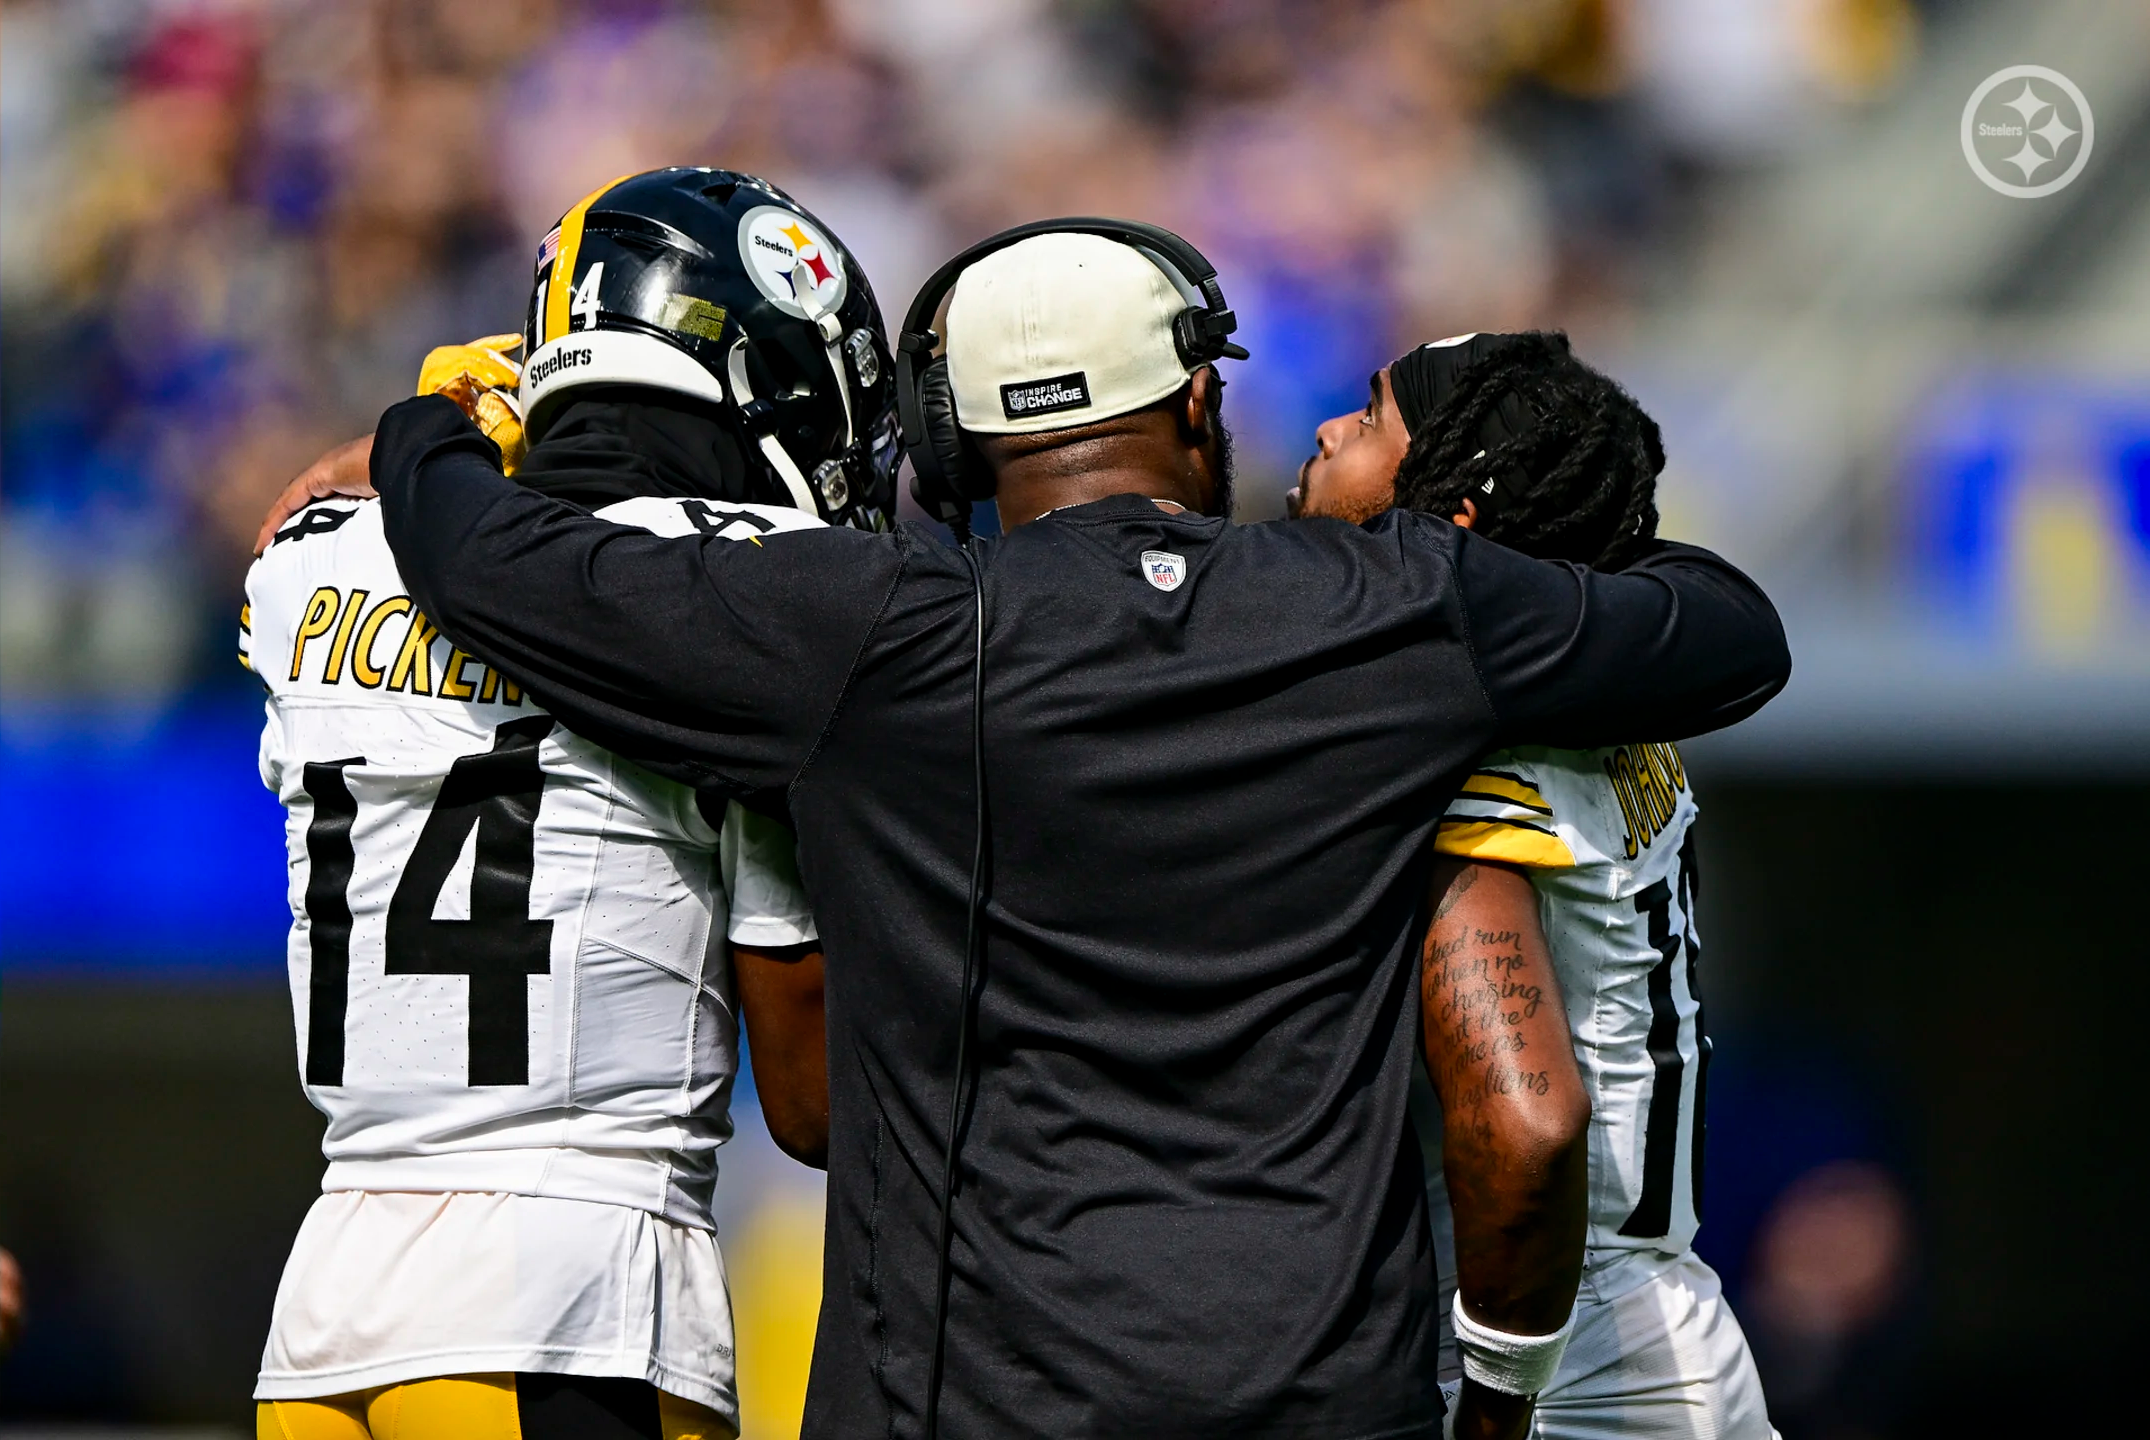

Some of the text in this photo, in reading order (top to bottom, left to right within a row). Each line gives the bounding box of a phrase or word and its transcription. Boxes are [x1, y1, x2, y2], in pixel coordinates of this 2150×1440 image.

[754, 235, 794, 257] Steelers
[530, 346, 592, 389] Steelers
[1024, 383, 1062, 397] INSPIRE
[1026, 387, 1083, 408] CHANGE
[1155, 573, 1177, 585] NFL
[303, 715, 556, 1087] 14
[1475, 929, 1521, 951] run
[1496, 954, 1527, 978] no
